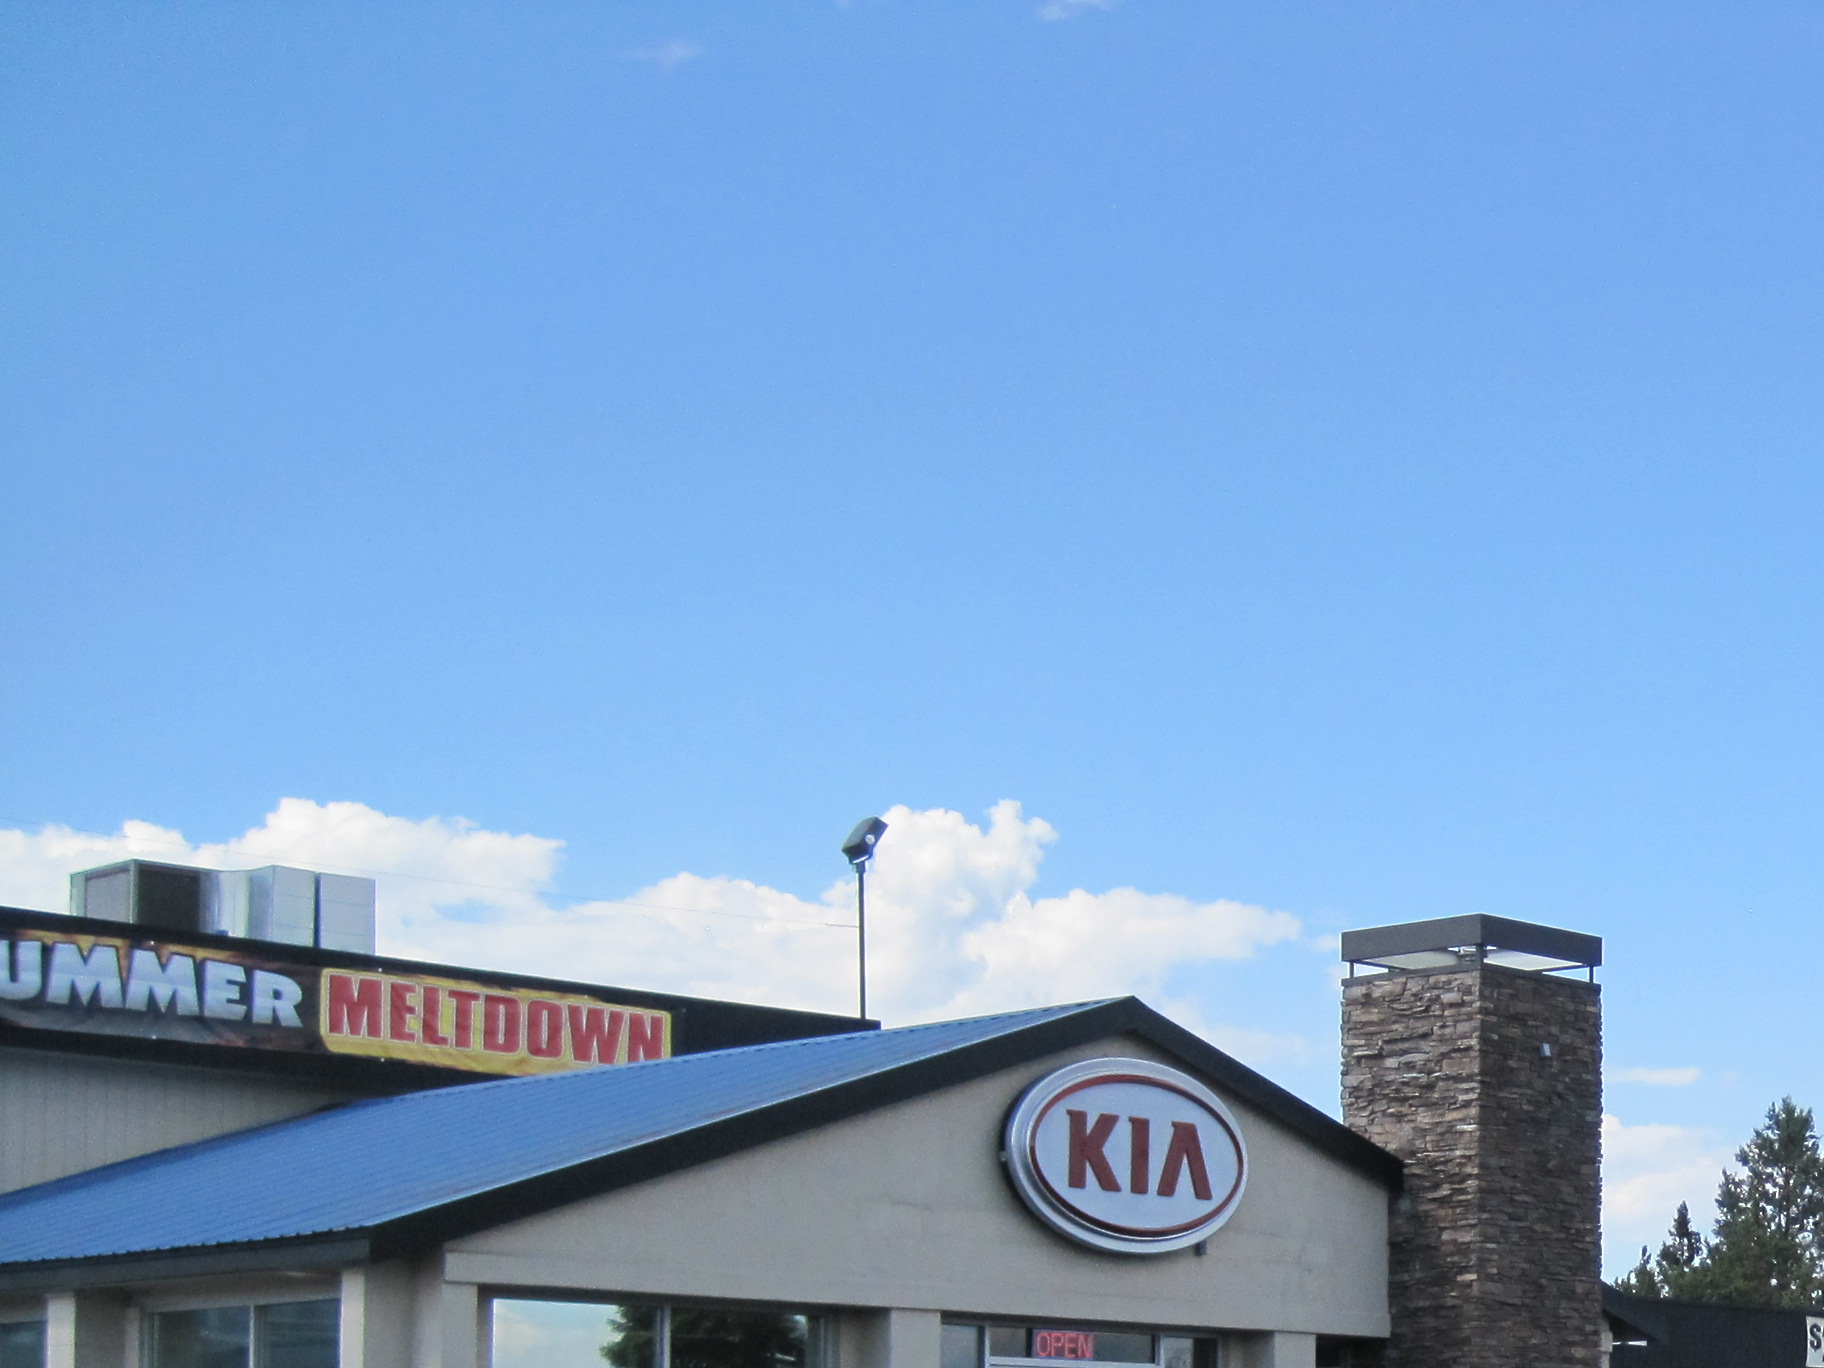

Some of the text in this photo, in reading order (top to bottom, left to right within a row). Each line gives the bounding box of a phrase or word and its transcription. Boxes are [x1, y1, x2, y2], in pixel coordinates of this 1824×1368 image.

[328, 973, 665, 1065] MELTDOWN
[1066, 1109, 1213, 1201] KIA
[1036, 1331, 1094, 1359] OPEN
